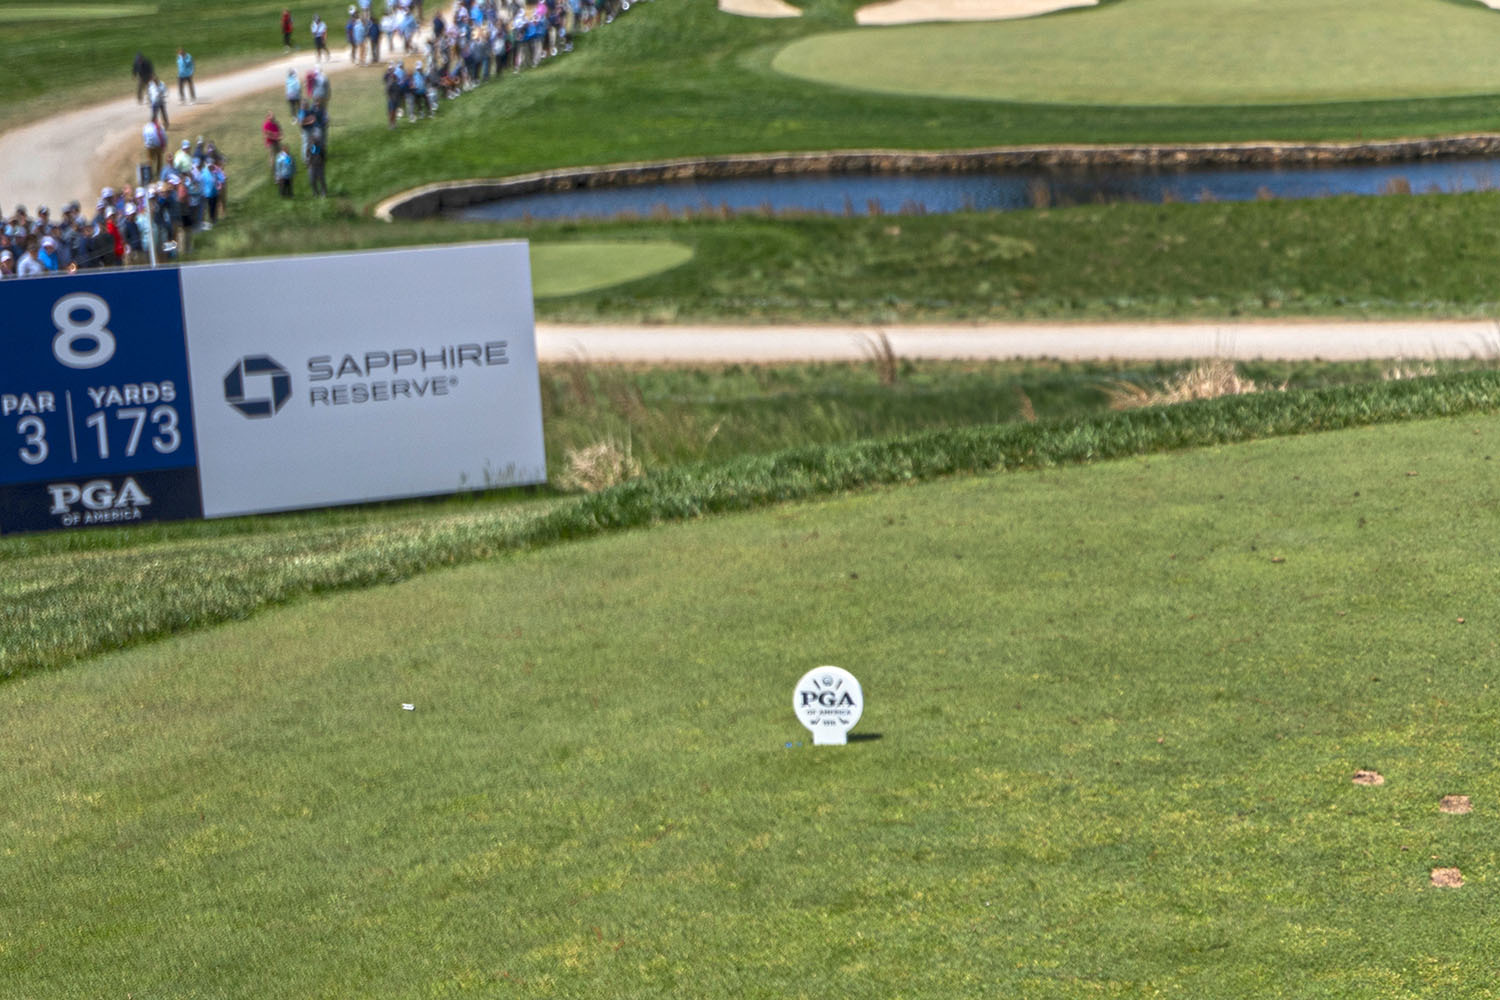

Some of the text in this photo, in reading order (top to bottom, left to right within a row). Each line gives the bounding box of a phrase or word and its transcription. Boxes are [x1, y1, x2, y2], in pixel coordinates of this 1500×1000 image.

[51, 291, 117, 370] 8
[306, 340, 510, 382] SAPPHIRE
[0, 391, 56, 416] PAR
[87, 380, 176, 408] YARDS
[16, 415, 49, 465] 3
[86, 404, 182, 459] 173
[47, 477, 152, 515] PGA
[61, 506, 143, 527] OF AMERICA
[801, 690, 856, 708] PGA
